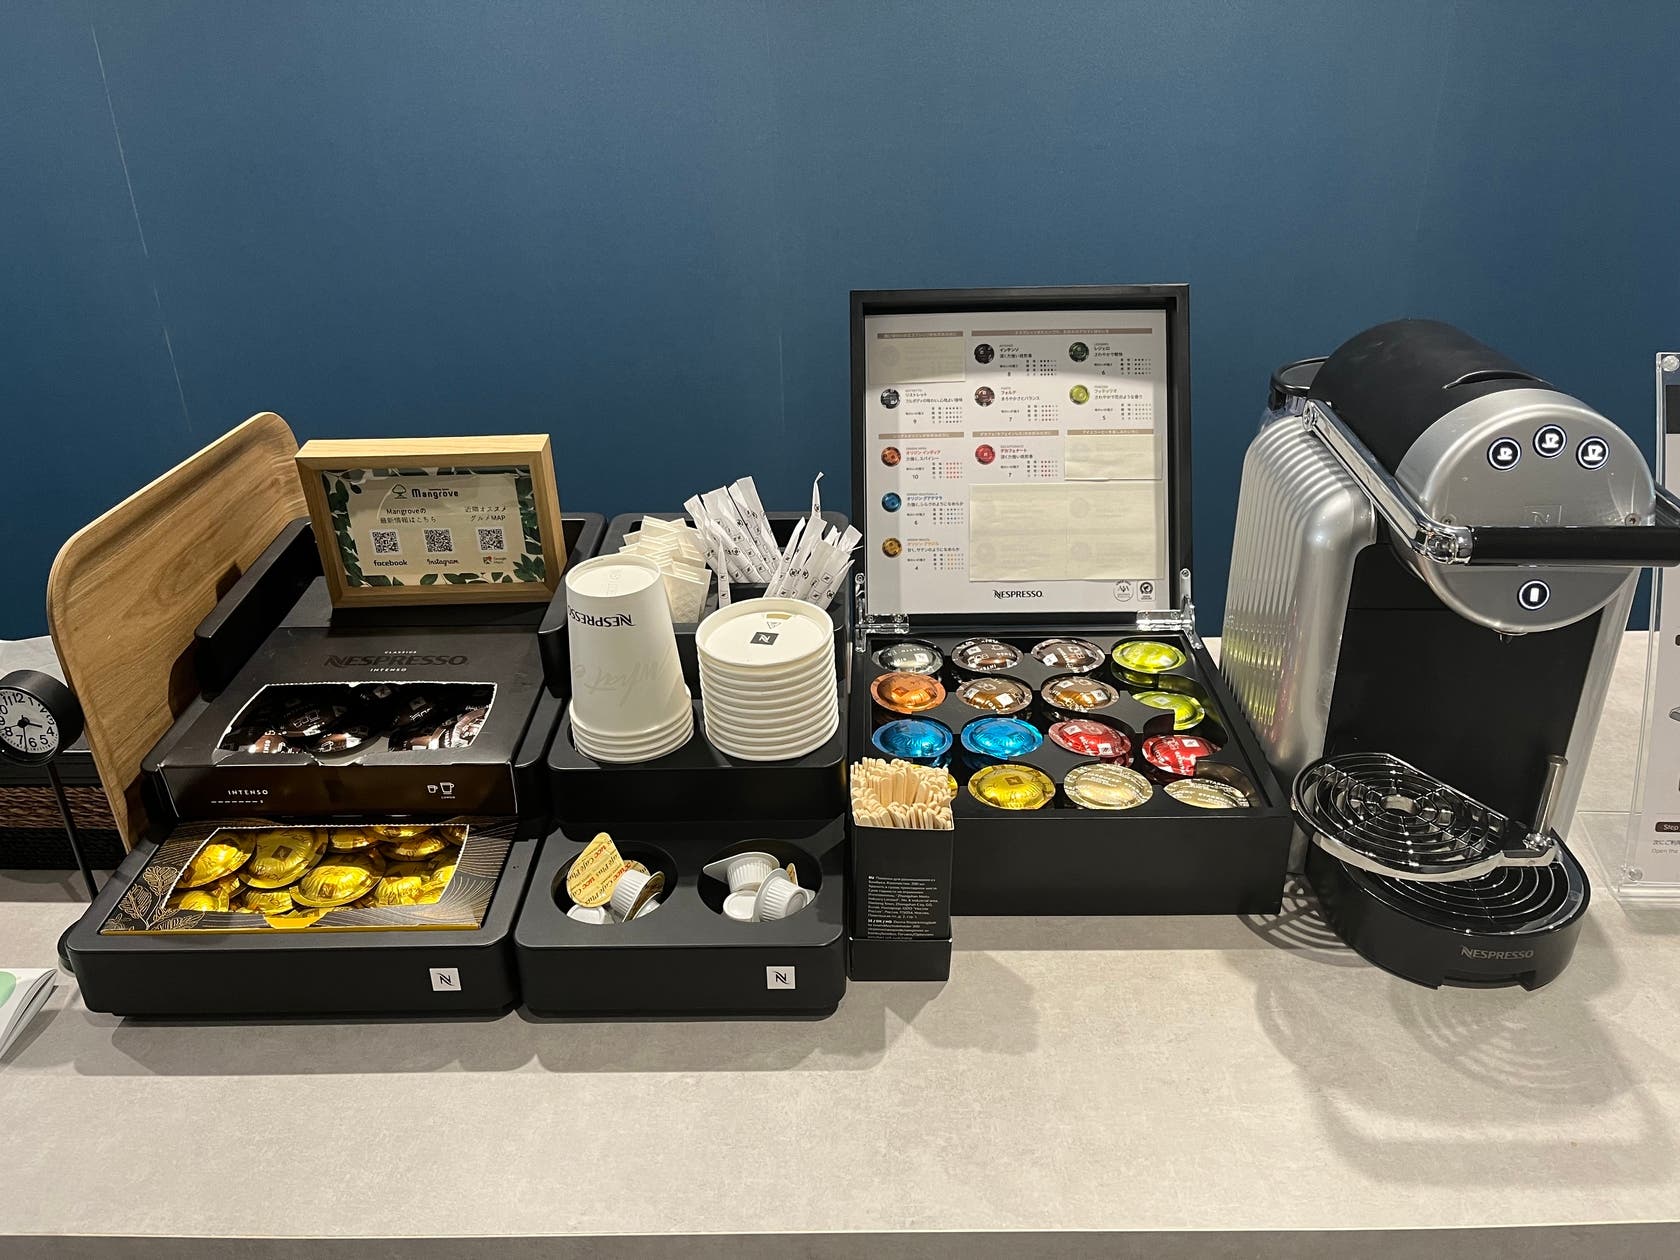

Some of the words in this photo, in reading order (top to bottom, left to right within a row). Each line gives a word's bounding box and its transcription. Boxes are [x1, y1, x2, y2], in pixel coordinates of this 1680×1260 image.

[412, 488, 459, 499] Mangrove
[373, 559, 408, 567] facebook
[427, 558, 459, 568] Instagram
[993, 589, 1043, 599] NESPRESSO
[568, 605, 636, 627] NESPRESS
[324, 655, 469, 668] NESPRESSO
[12, 692, 25, 703] 12
[29, 738, 37, 747] 6
[40, 735, 48, 744] 5
[1461, 946, 1534, 960] NESPRESSO
